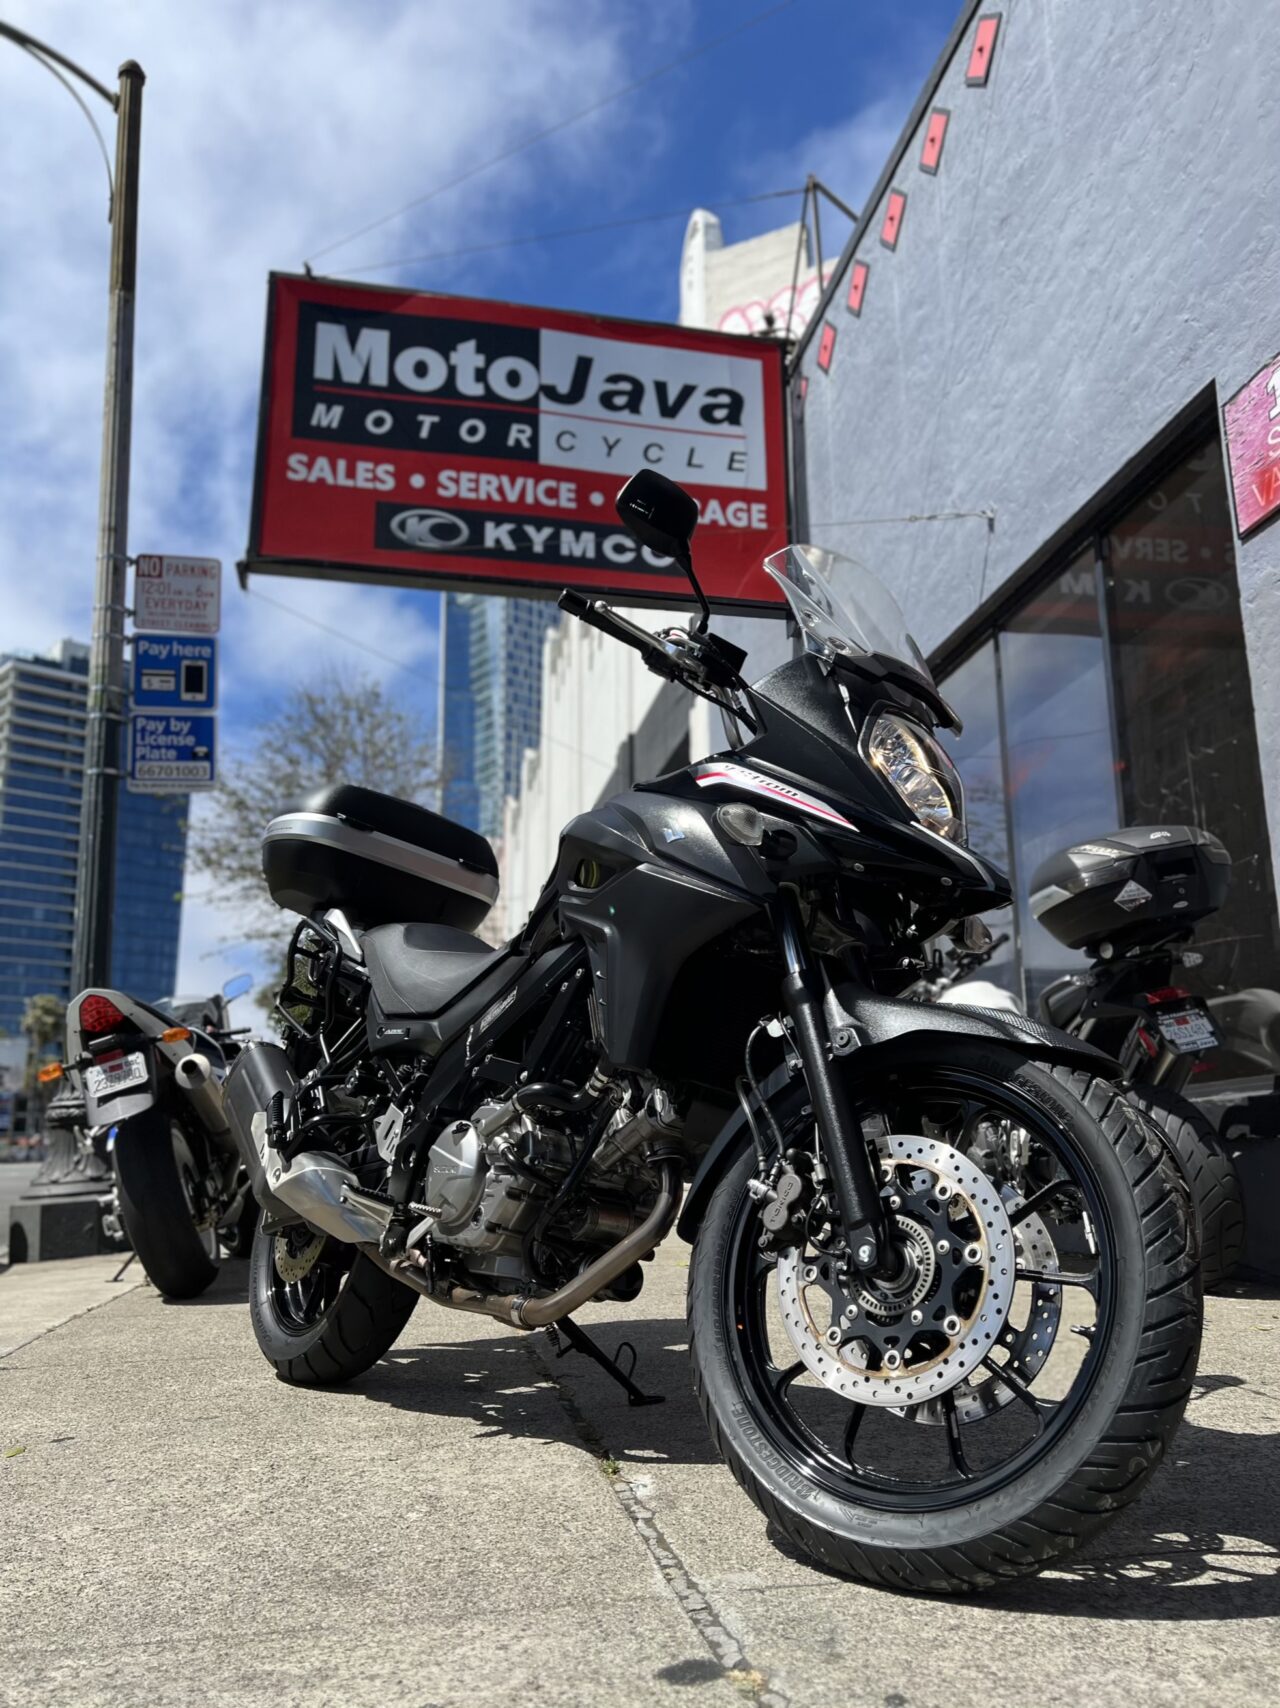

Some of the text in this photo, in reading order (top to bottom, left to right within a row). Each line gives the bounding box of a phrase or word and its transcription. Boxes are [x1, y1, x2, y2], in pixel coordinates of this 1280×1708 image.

[286, 453, 396, 491] SALES
[436, 469, 578, 510] SERVICE
[138, 556, 217, 580] NO PARKING
[144, 596, 208, 611] EVERYDAY
[138, 640, 212, 660] Pay here
[136, 717, 192, 735] Pay by
[136, 732, 195, 747] License
[136, 747, 177, 760] Plate
